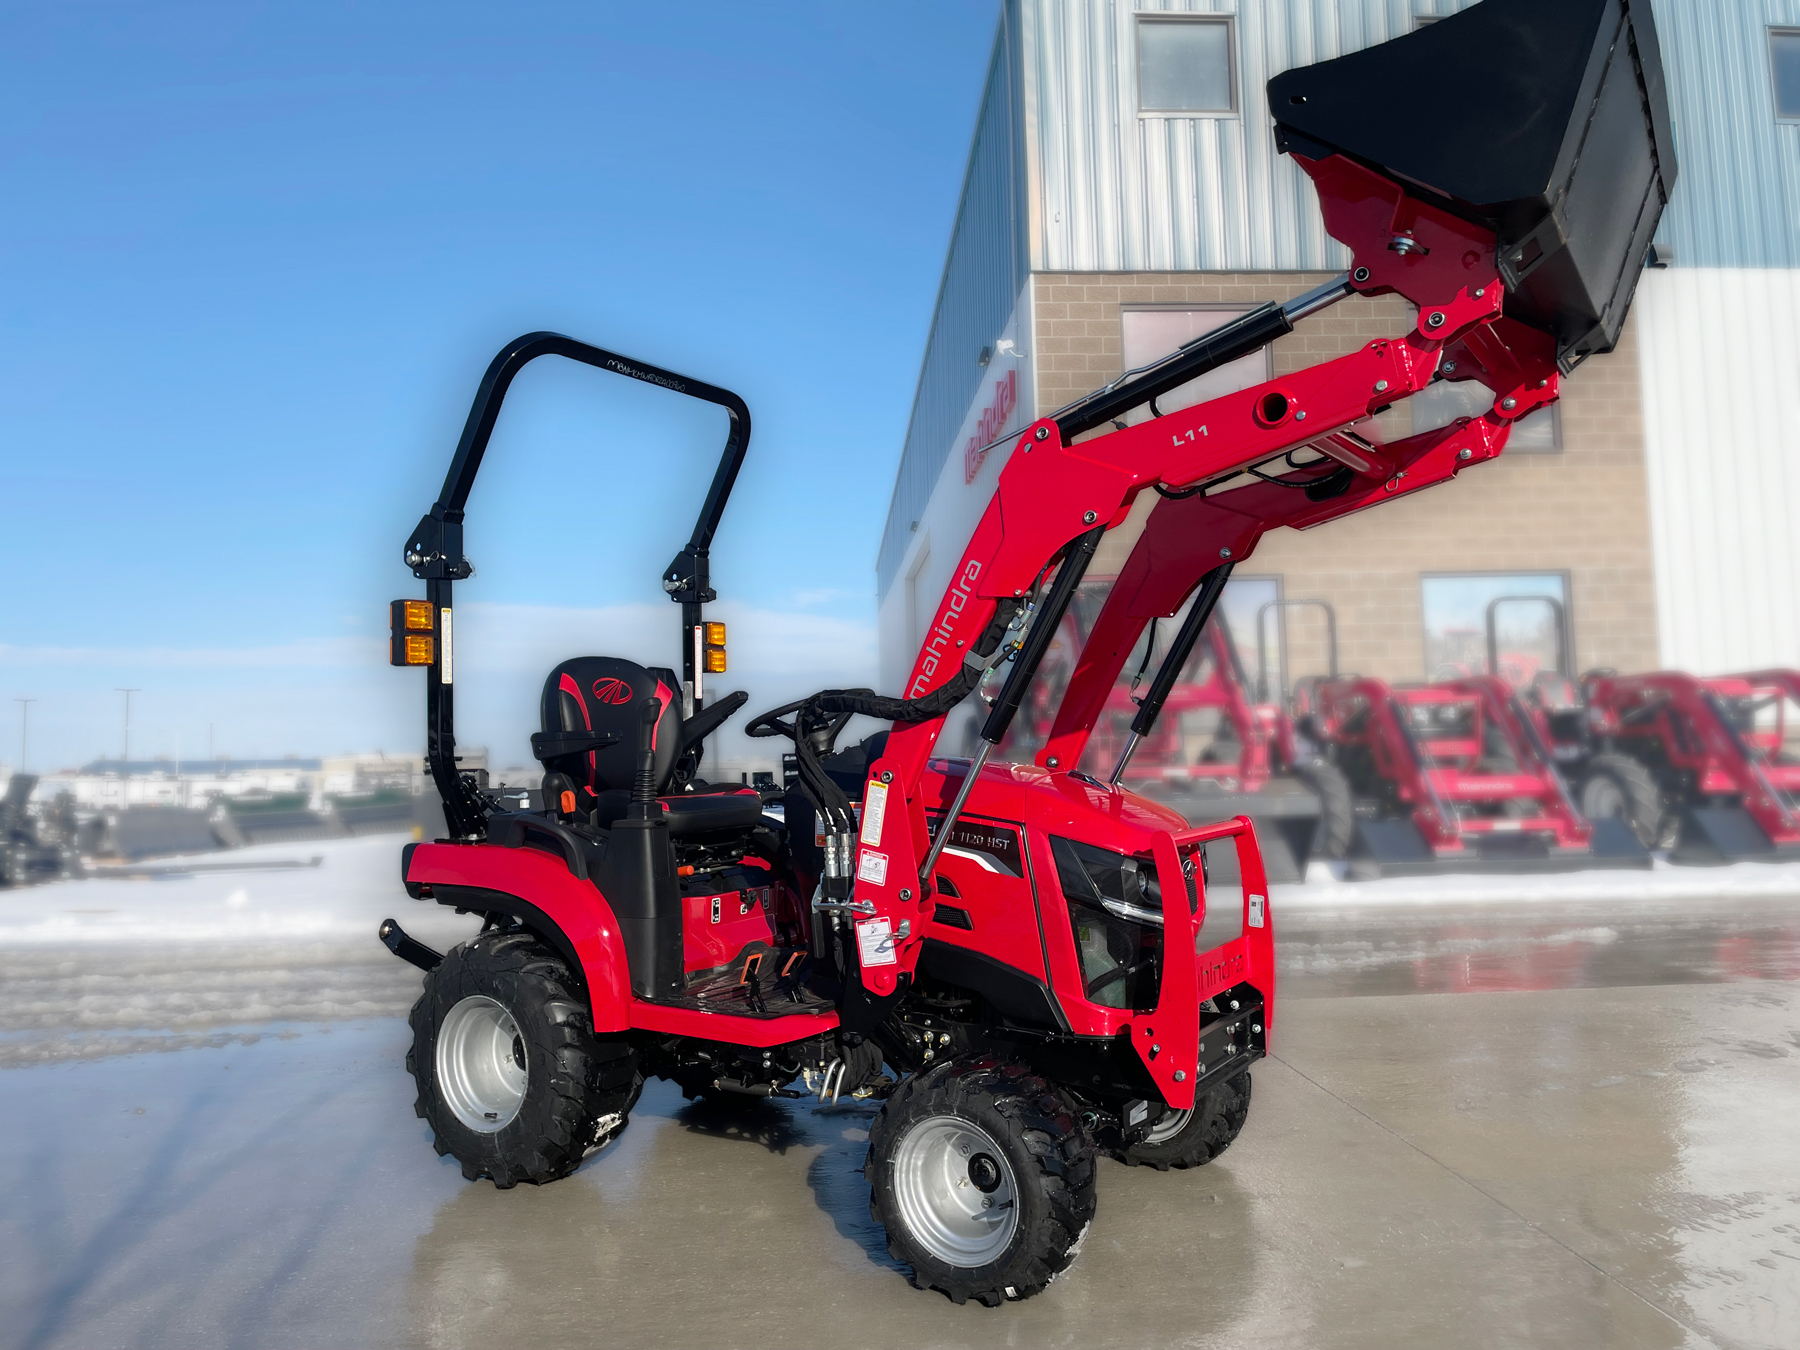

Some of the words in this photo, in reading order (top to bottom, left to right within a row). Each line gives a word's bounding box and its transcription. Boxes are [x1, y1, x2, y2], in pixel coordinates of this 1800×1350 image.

[1172, 424, 1209, 447] L11
[908, 559, 982, 700] mahindra
[959, 831, 984, 846] 1120
[987, 836, 1010, 850] HST
[1200, 953, 1244, 992] hindra
